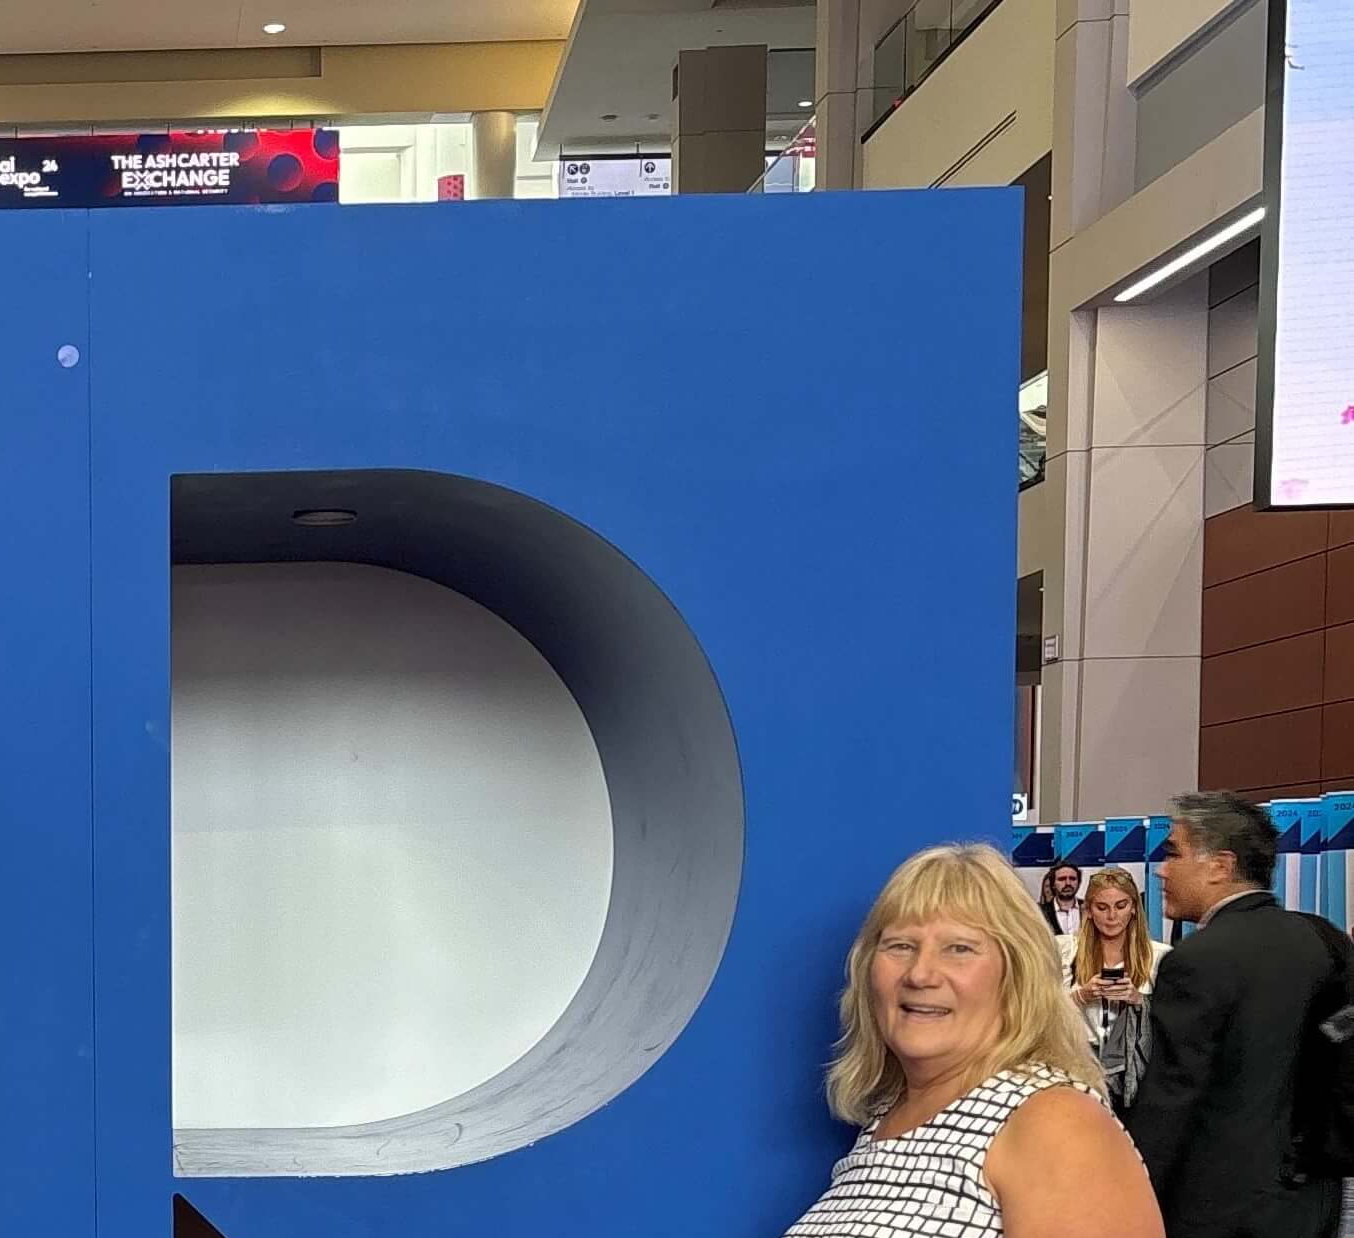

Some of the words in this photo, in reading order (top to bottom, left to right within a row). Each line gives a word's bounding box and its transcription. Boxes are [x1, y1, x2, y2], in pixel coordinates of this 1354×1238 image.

[111, 154, 143, 170] THE
[121, 169, 230, 190] EXCHANGE
[1276, 809, 1298, 818] 2024
